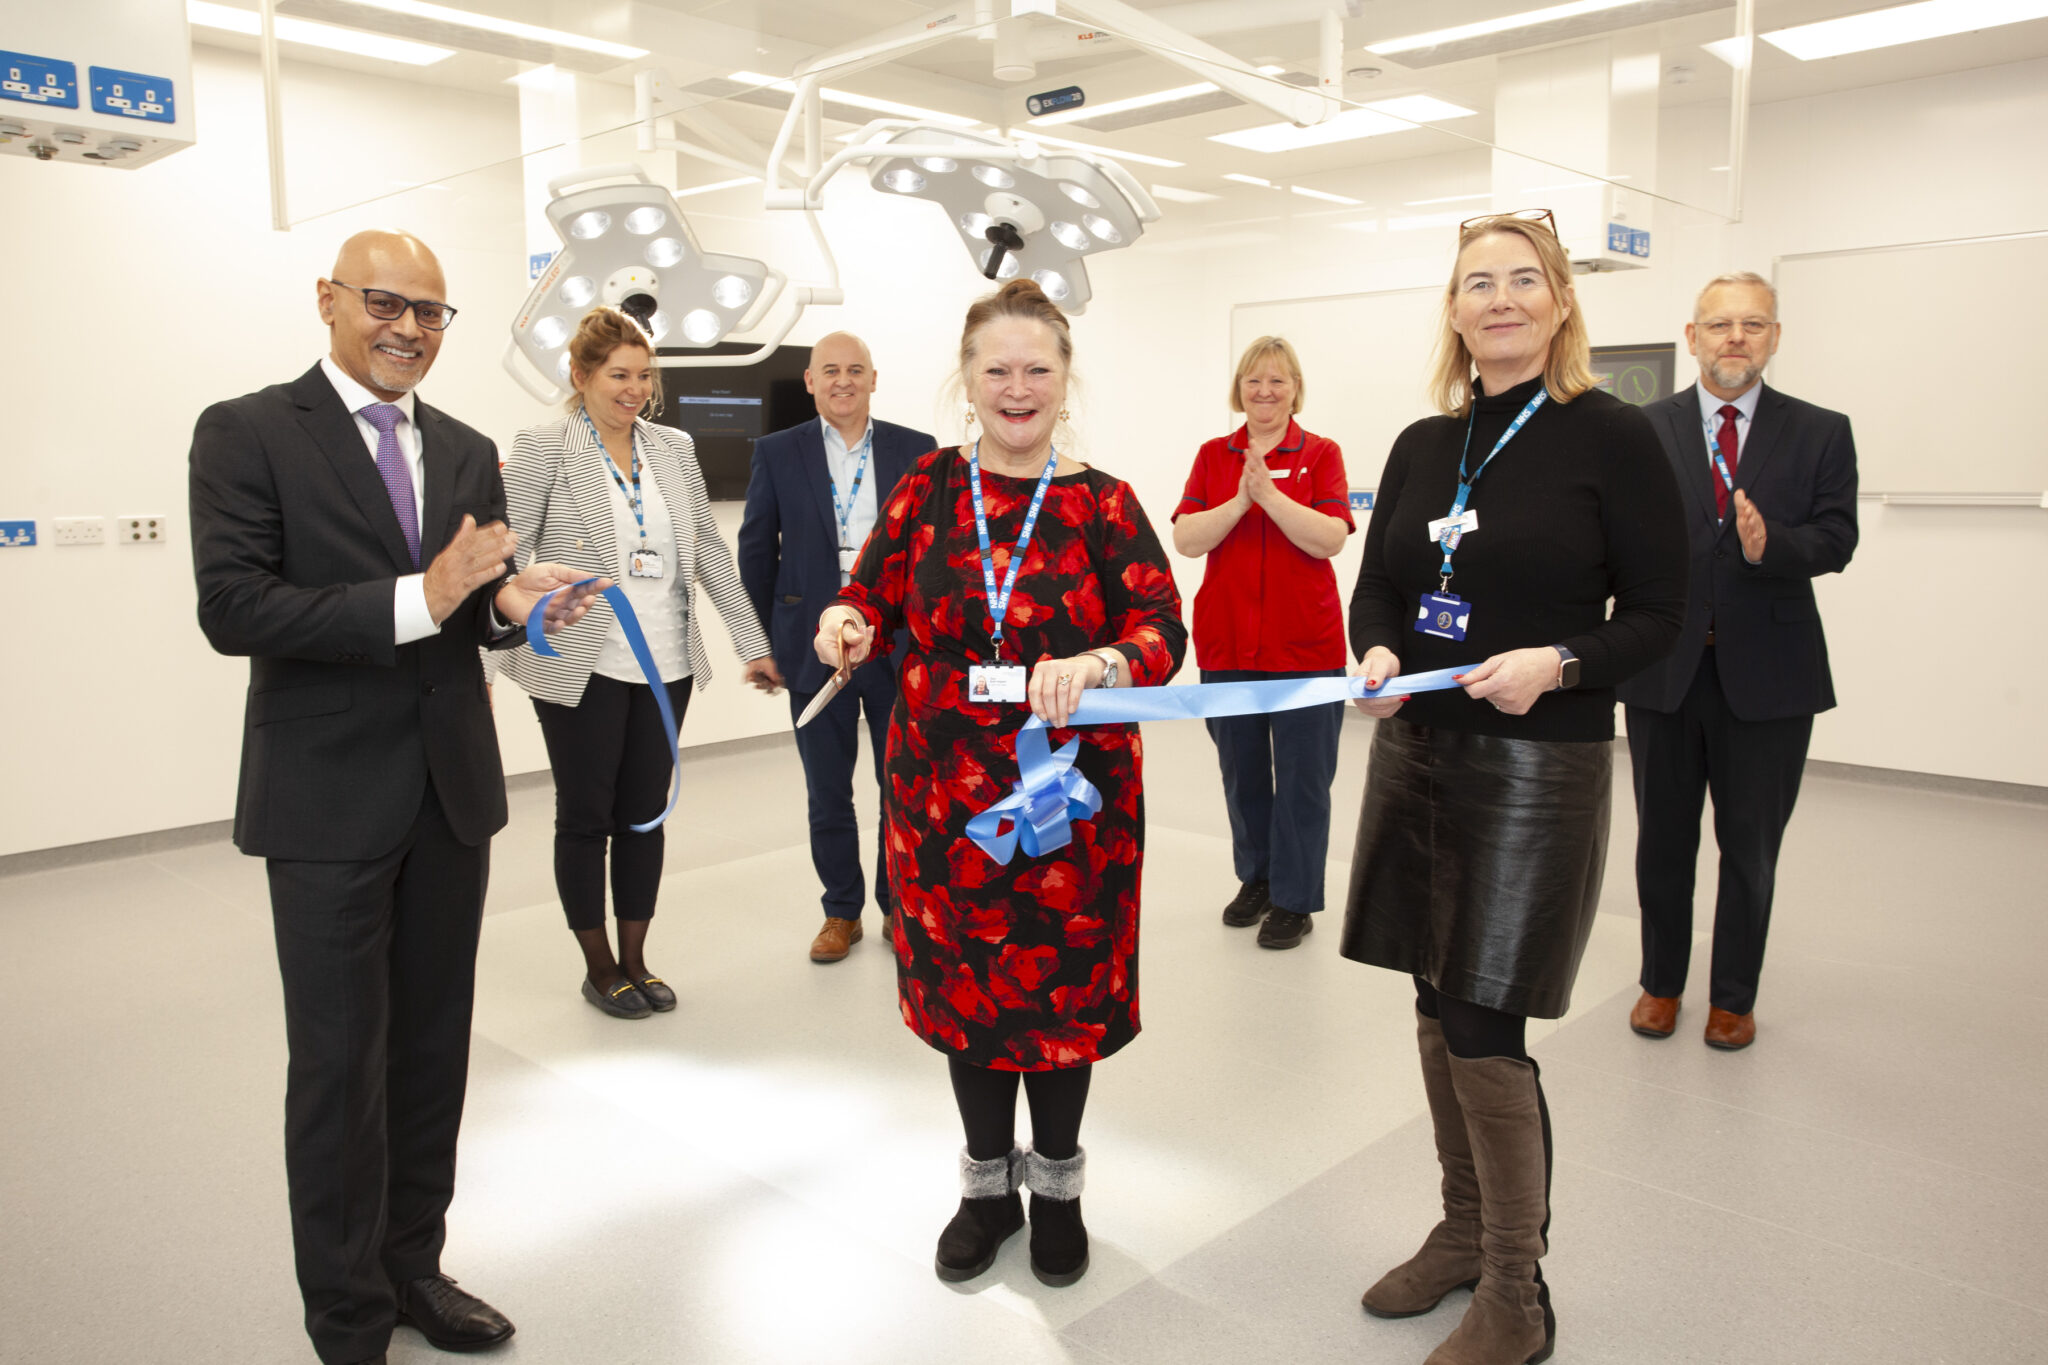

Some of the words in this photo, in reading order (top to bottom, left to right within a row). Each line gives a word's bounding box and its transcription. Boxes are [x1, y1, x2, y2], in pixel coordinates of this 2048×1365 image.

[1077, 32, 1093, 40] KLS
[1499, 428, 1515, 444] NHS
[1515, 408, 1532, 426] NHS
[1531, 390, 1547, 408] NHS
[1043, 465, 1054, 481] NHS
[972, 480, 980, 495] NHS
[1035, 483, 1047, 499] NHS
[974, 499, 983, 515] NHS
[1028, 502, 1040, 519] NHS
[977, 519, 987, 535] NHS
[1021, 522, 1033, 539] NHS
[985, 570, 995, 586] NHS
[1004, 569, 1016, 587] NHS
[988, 591, 998, 609] NHS
[998, 591, 1009, 610] NHS
